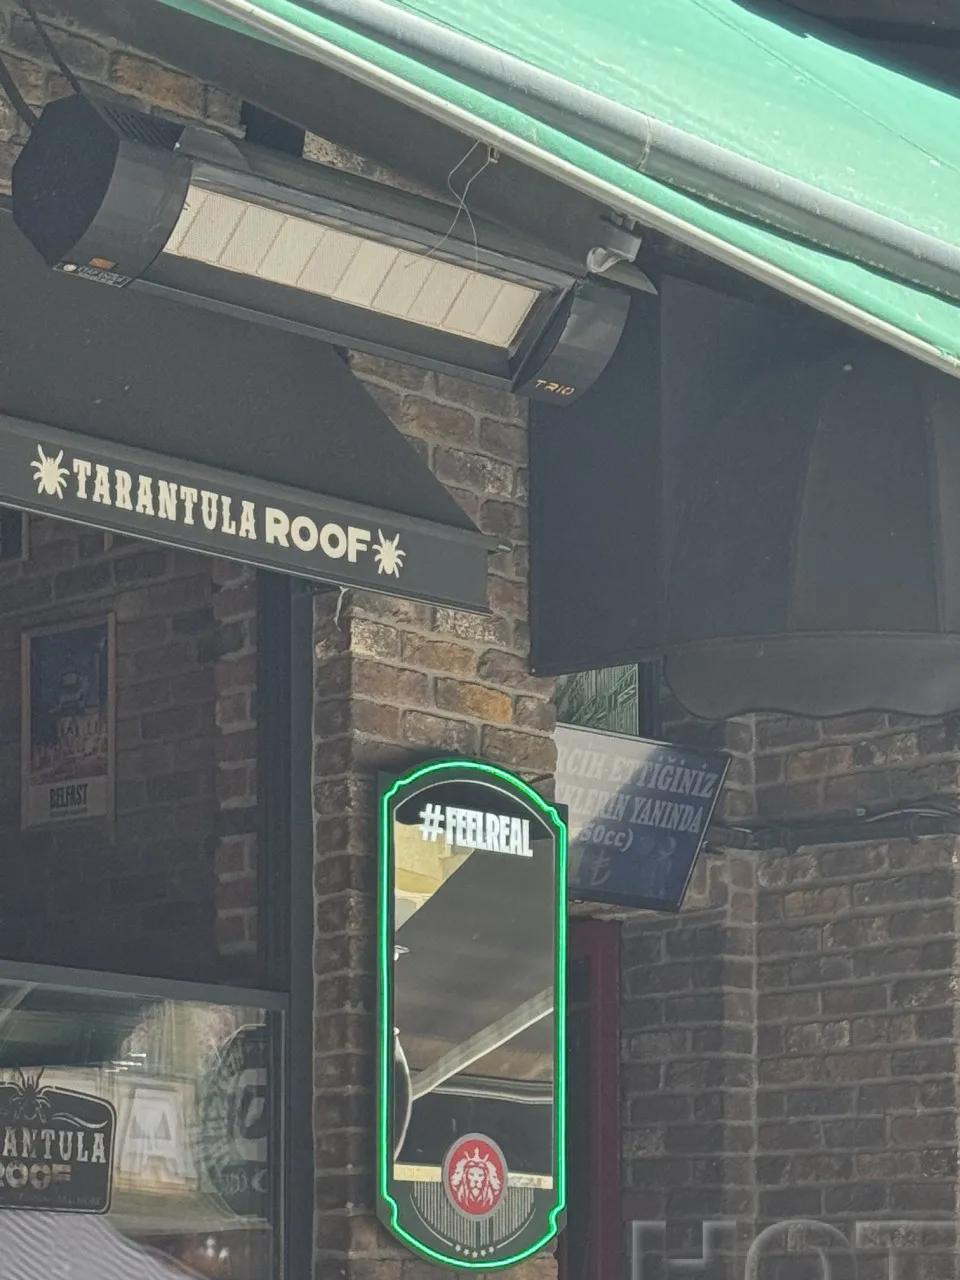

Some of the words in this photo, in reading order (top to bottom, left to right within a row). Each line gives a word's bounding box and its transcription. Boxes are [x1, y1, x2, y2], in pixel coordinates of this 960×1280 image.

[72, 458, 257, 541] TARANTULA
[265, 507, 372, 563] ROOF
[50, 784, 88, 808] BELFAST
[629, 797, 704, 834] YANINDA
